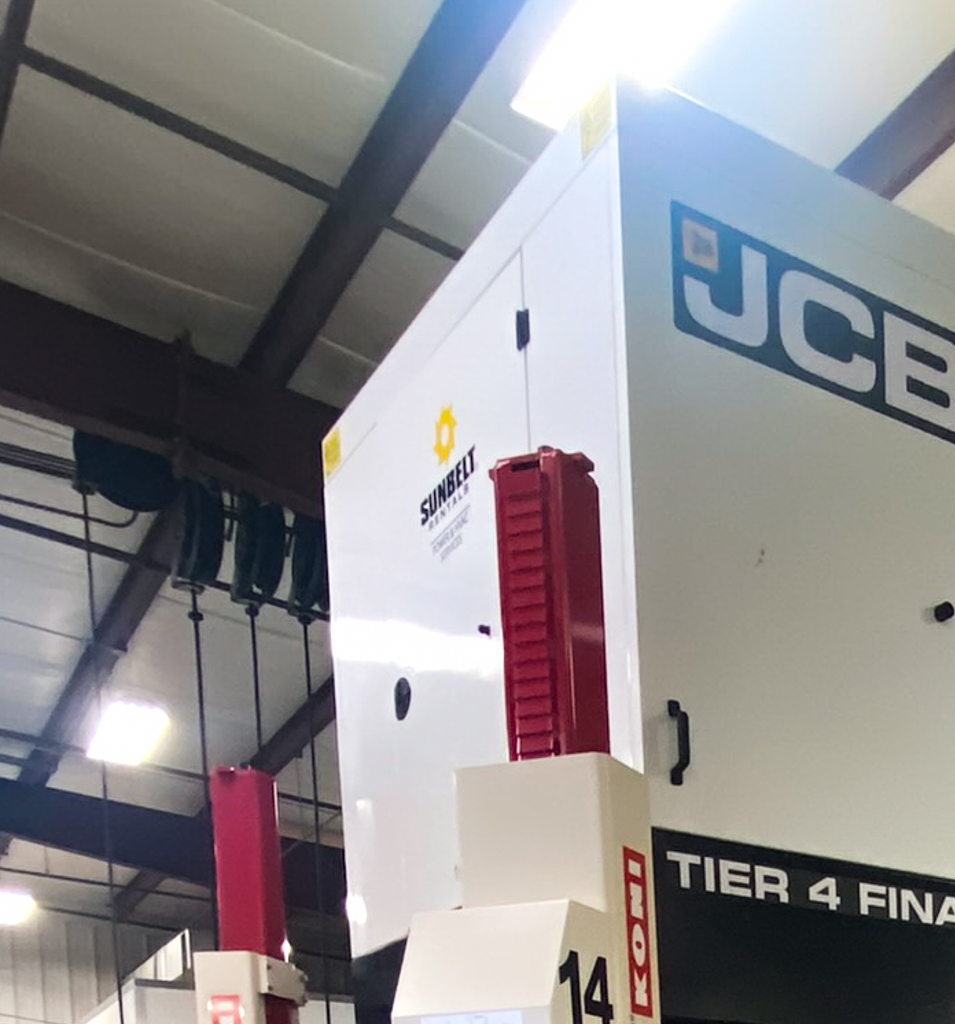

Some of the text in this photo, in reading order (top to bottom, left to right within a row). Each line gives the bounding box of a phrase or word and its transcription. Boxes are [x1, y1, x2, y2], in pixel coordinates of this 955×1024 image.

[420, 444, 476, 526] SUNBELT
[428, 483, 469, 531] RENTALS
[666, 850, 790, 904] TIER
[808, 876, 841, 911] 4
[627, 857, 650, 1008] KONI
